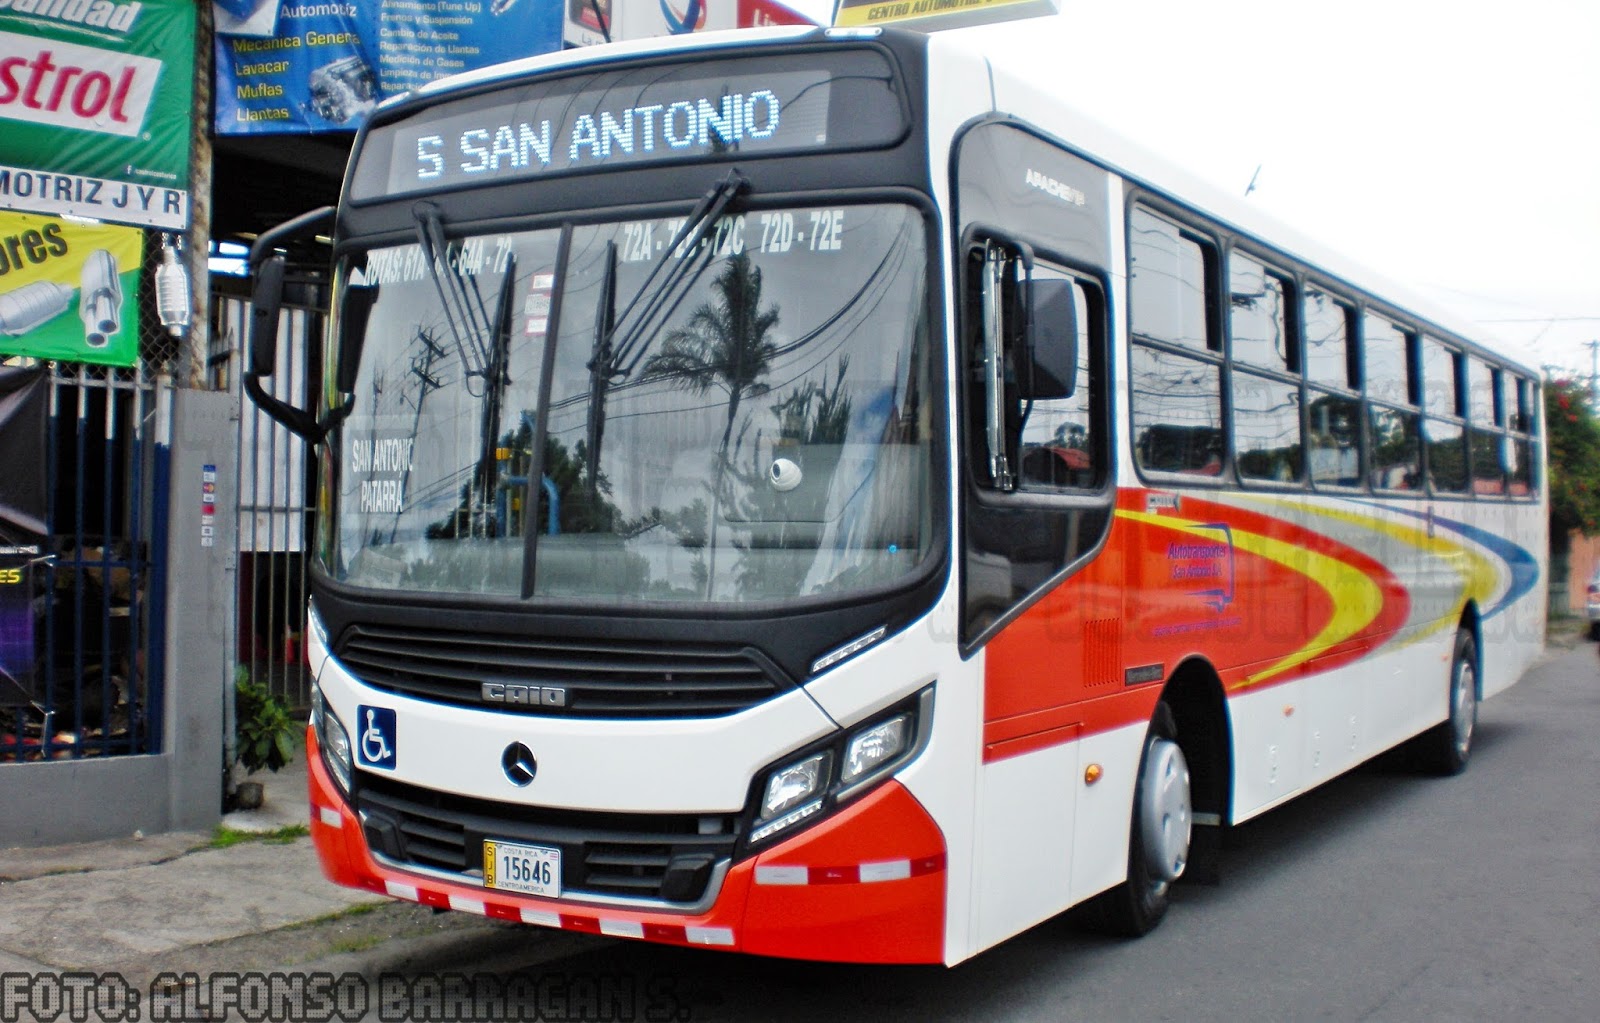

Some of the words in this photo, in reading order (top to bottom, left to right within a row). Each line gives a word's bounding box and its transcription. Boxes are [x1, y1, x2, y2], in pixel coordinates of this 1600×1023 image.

[868, 3, 910, 20] CENTRO
[380, 28, 415, 38] Cambio
[418, 30, 429, 39] de
[431, 31, 458, 40] Aceite
[435, 45, 446, 53] de
[235, 61, 289, 76] Lavacar
[423, 57, 434, 66] de
[420, 71, 432, 79] de
[237, 83, 283, 99] Muflas
[236, 108, 289, 122] Llantas
[460, 119, 551, 173] SAN
[568, 89, 780, 160] ANTONIO
[112, 184, 128, 208] J
[136, 186, 155, 211] Y
[163, 190, 180, 215] R
[624, 222, 652, 261] 72A
[713, 215, 745, 256] 72C
[761, 212, 793, 253] 72D
[809, 210, 844, 251] 72E
[353, 439, 372, 473] SAN
[504, 847, 523, 856] COSTA
[525, 849, 538, 858] RICA
[503, 855, 551, 886] 15646
[498, 880, 545, 894] CENTROAMERICA
